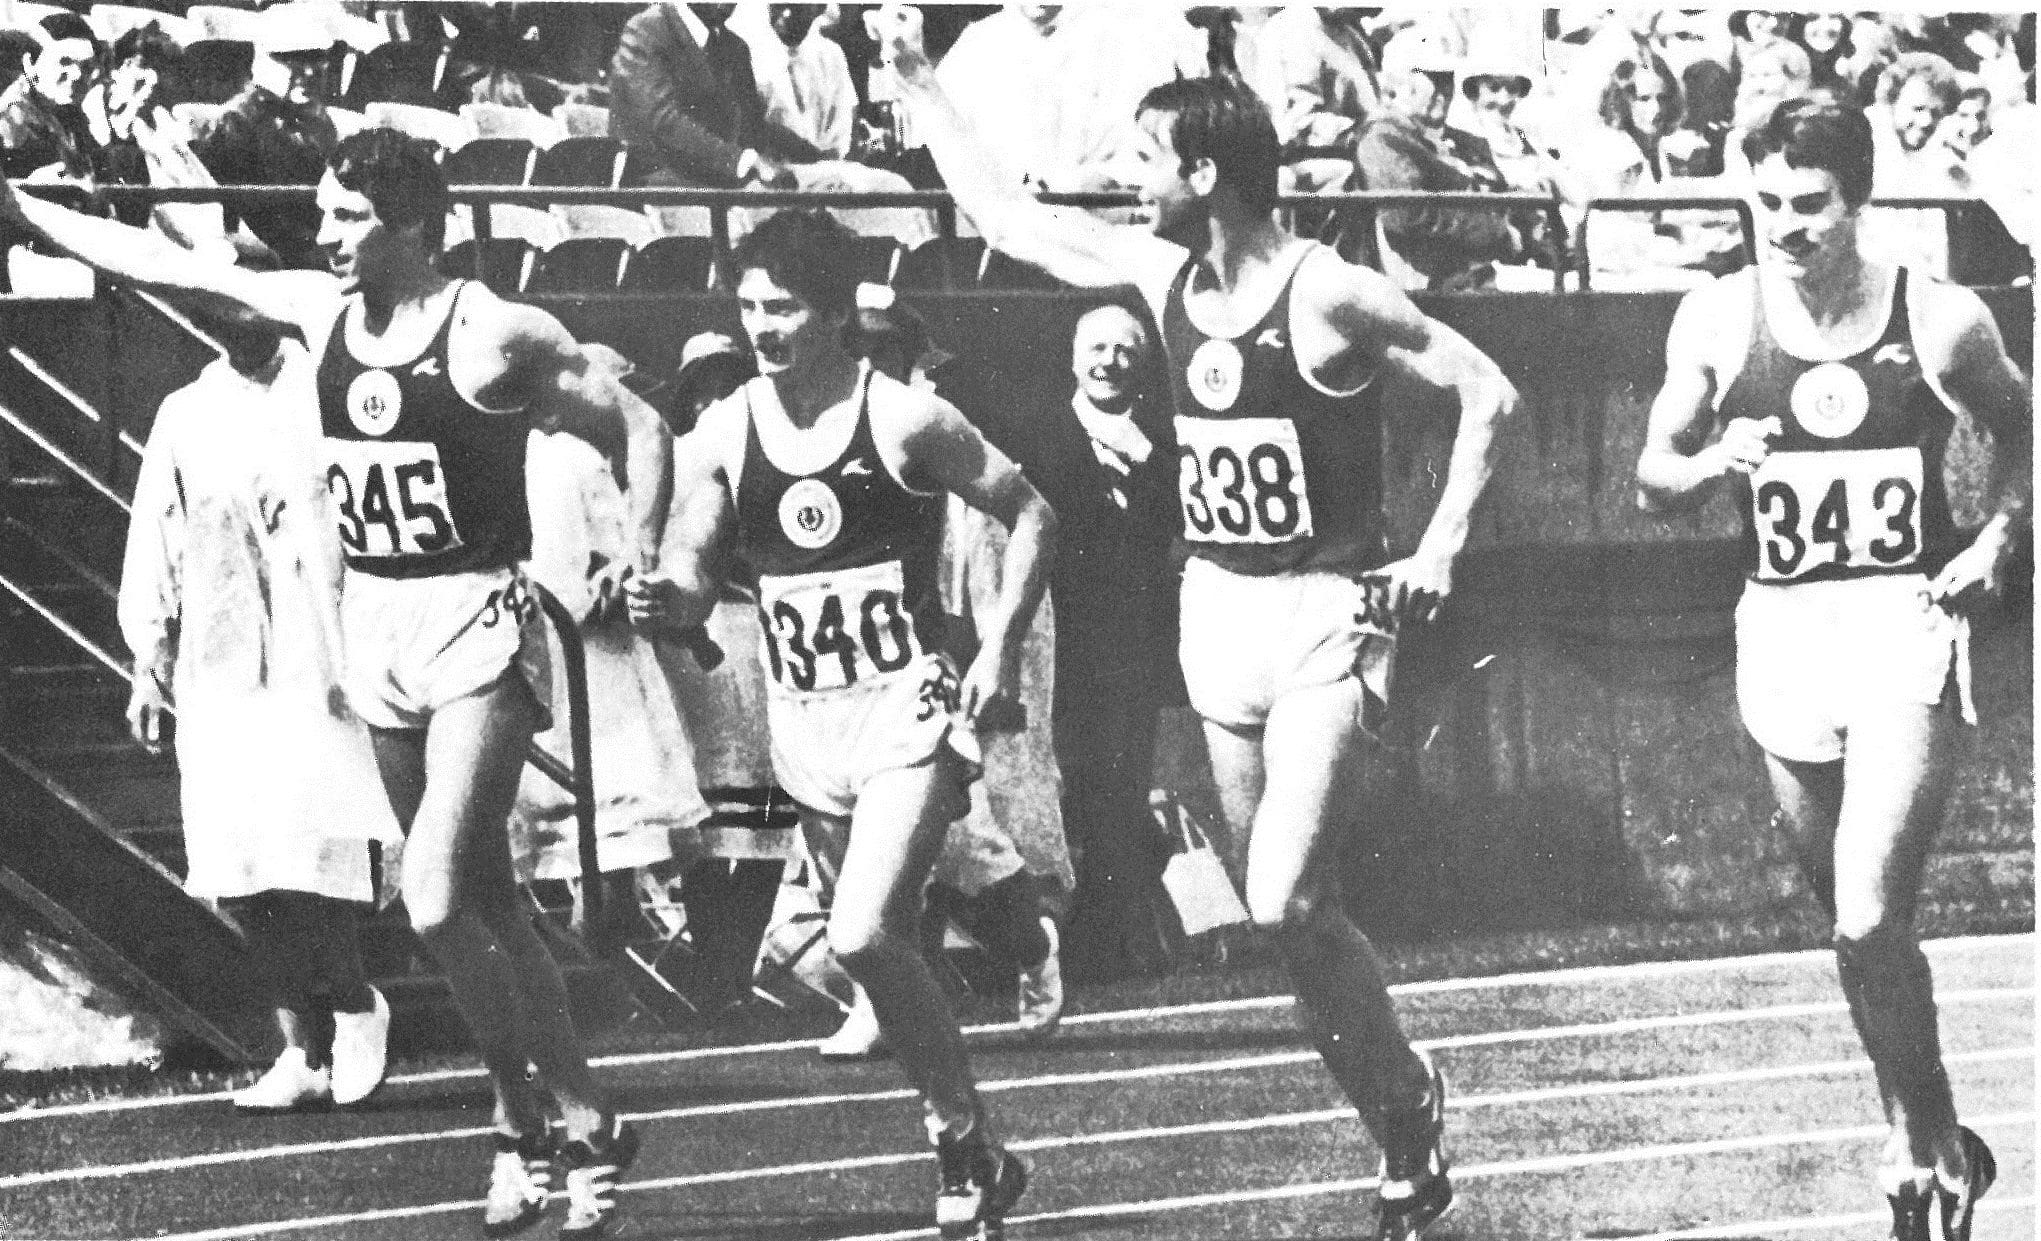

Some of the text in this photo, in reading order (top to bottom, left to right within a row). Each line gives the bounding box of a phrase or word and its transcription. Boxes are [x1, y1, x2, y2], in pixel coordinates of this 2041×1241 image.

[327, 459, 453, 552] 345
[1178, 443, 1299, 537] 338
[1758, 477, 1917, 576] 343
[774, 589, 912, 692] 340
